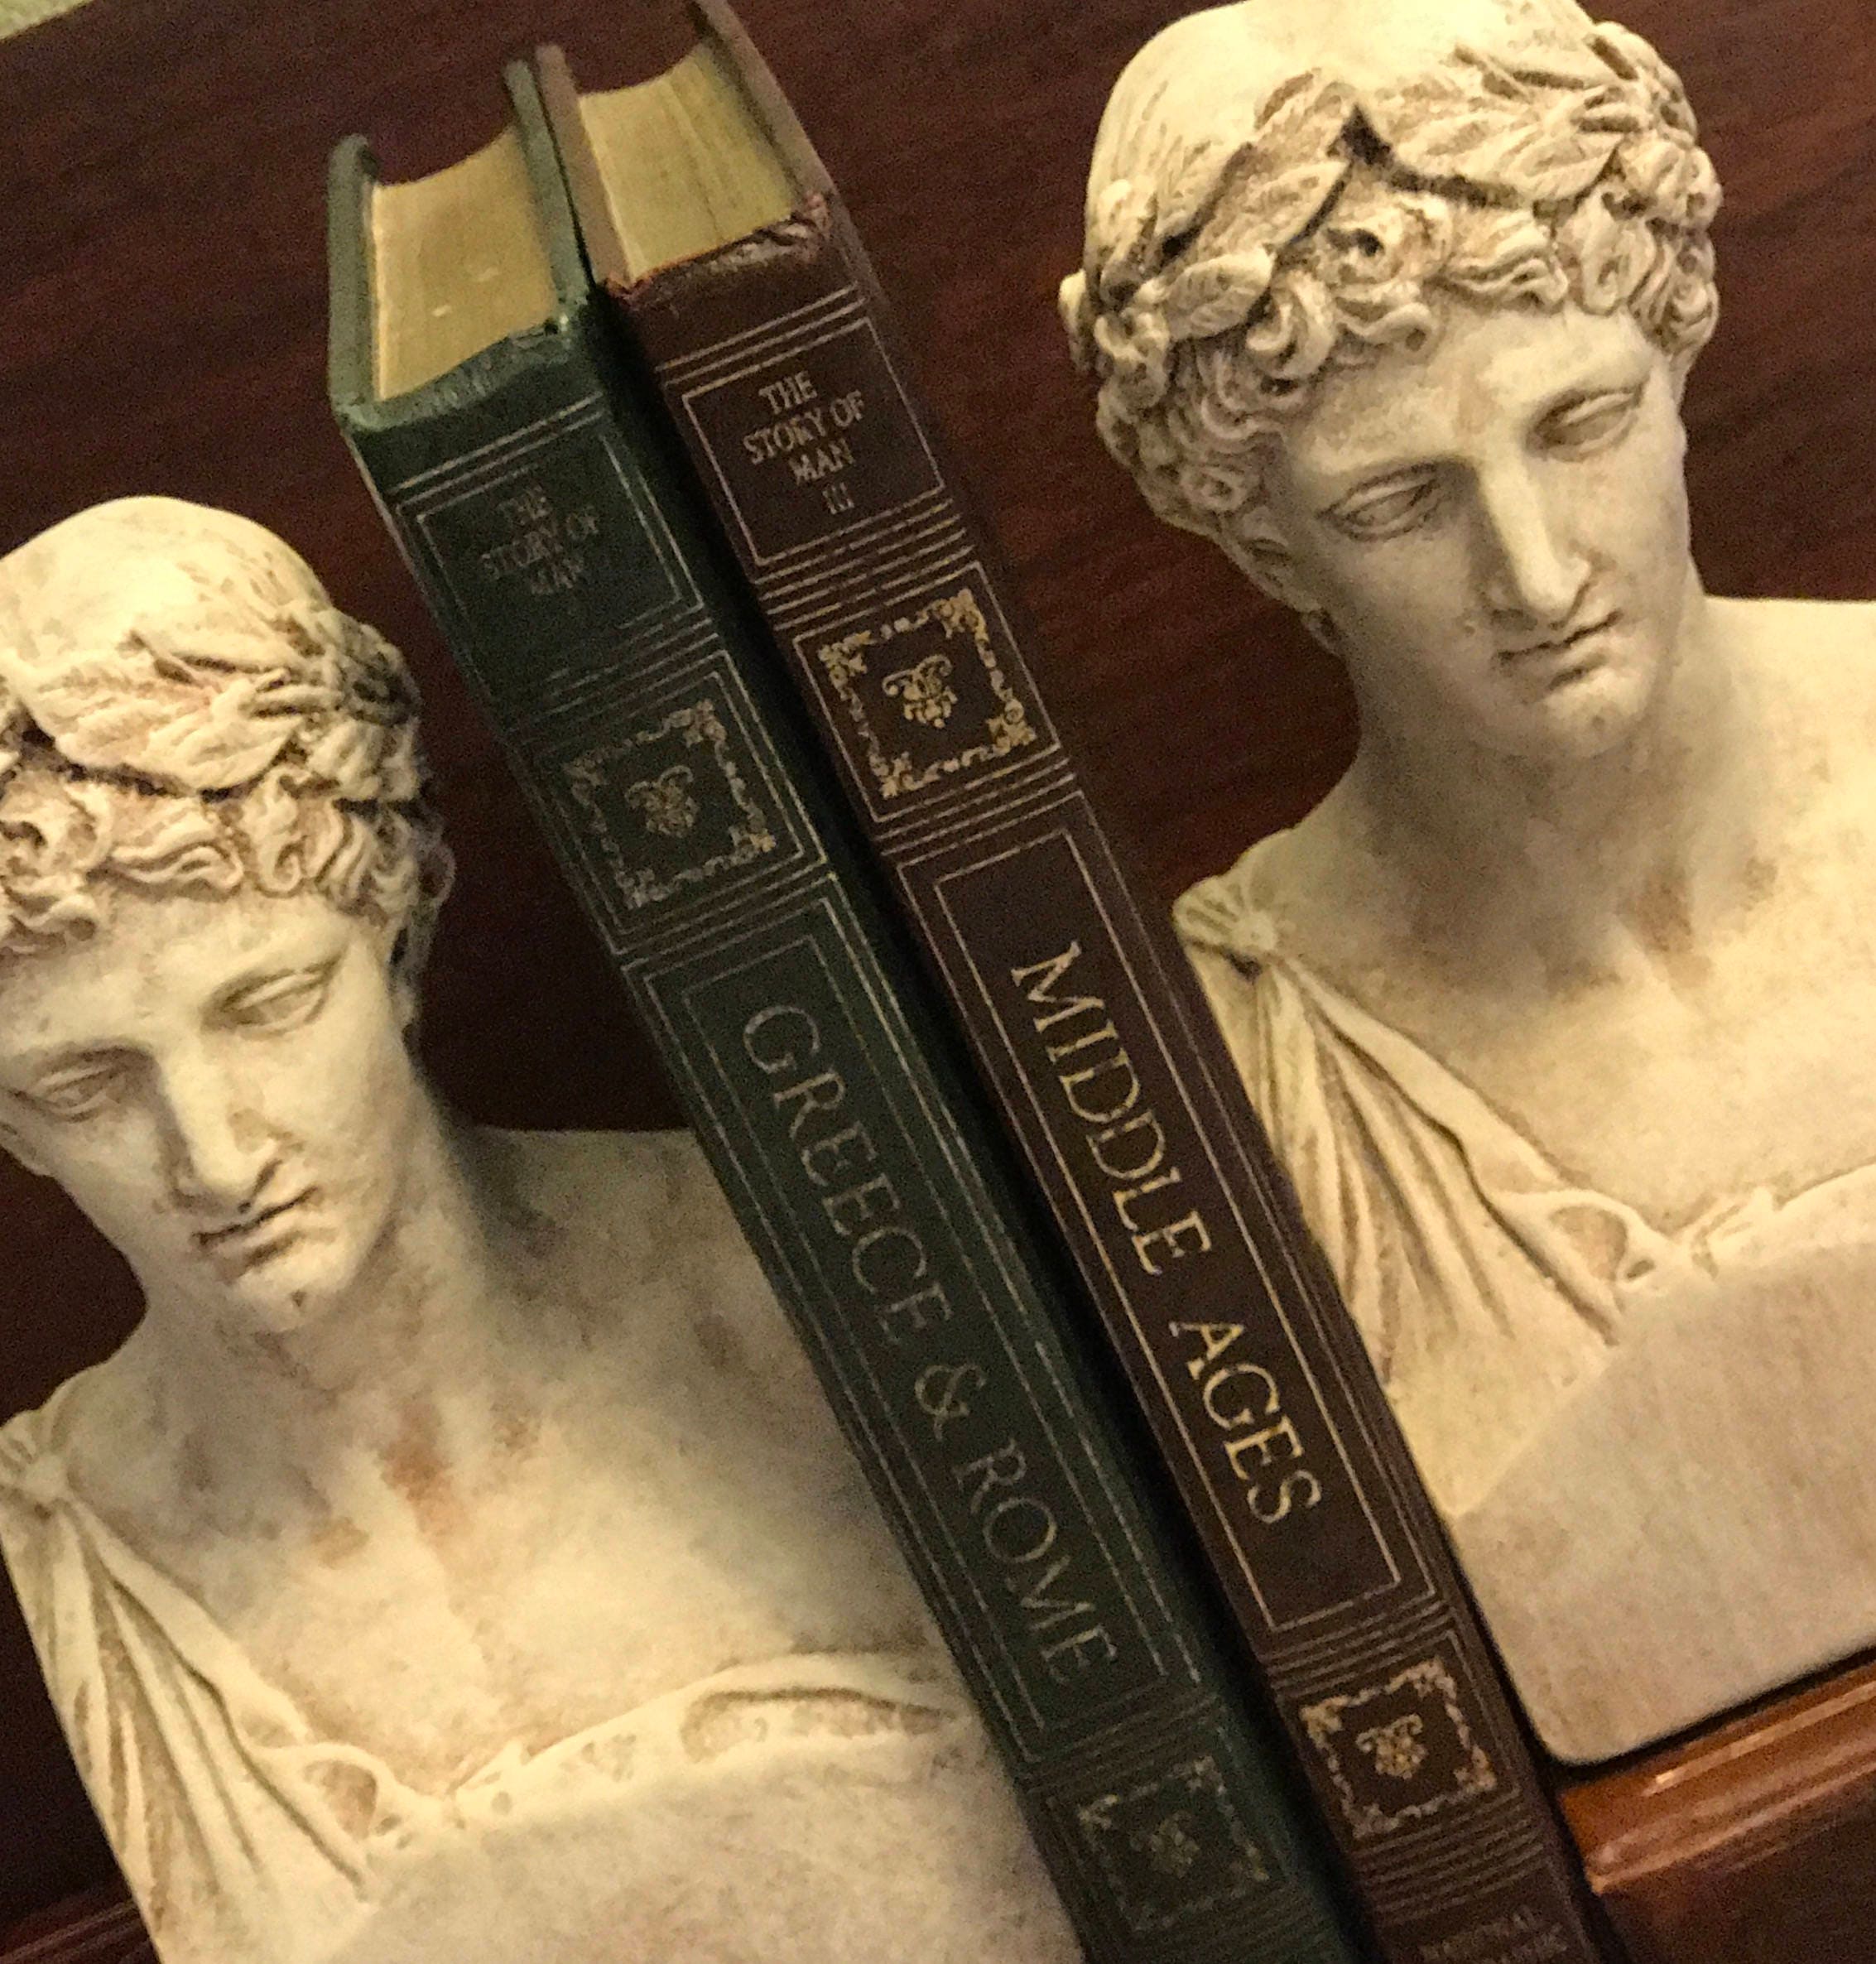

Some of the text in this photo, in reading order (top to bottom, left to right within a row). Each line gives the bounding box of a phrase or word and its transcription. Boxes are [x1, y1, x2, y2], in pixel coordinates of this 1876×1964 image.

[743, 389, 864, 465] STORY OF
[758, 370, 819, 415] THE
[788, 439, 857, 485] MAN
[1011, 939, 1323, 1525] MIDDLE AGES
[743, 1004, 1118, 1683] GREECE & ROME
